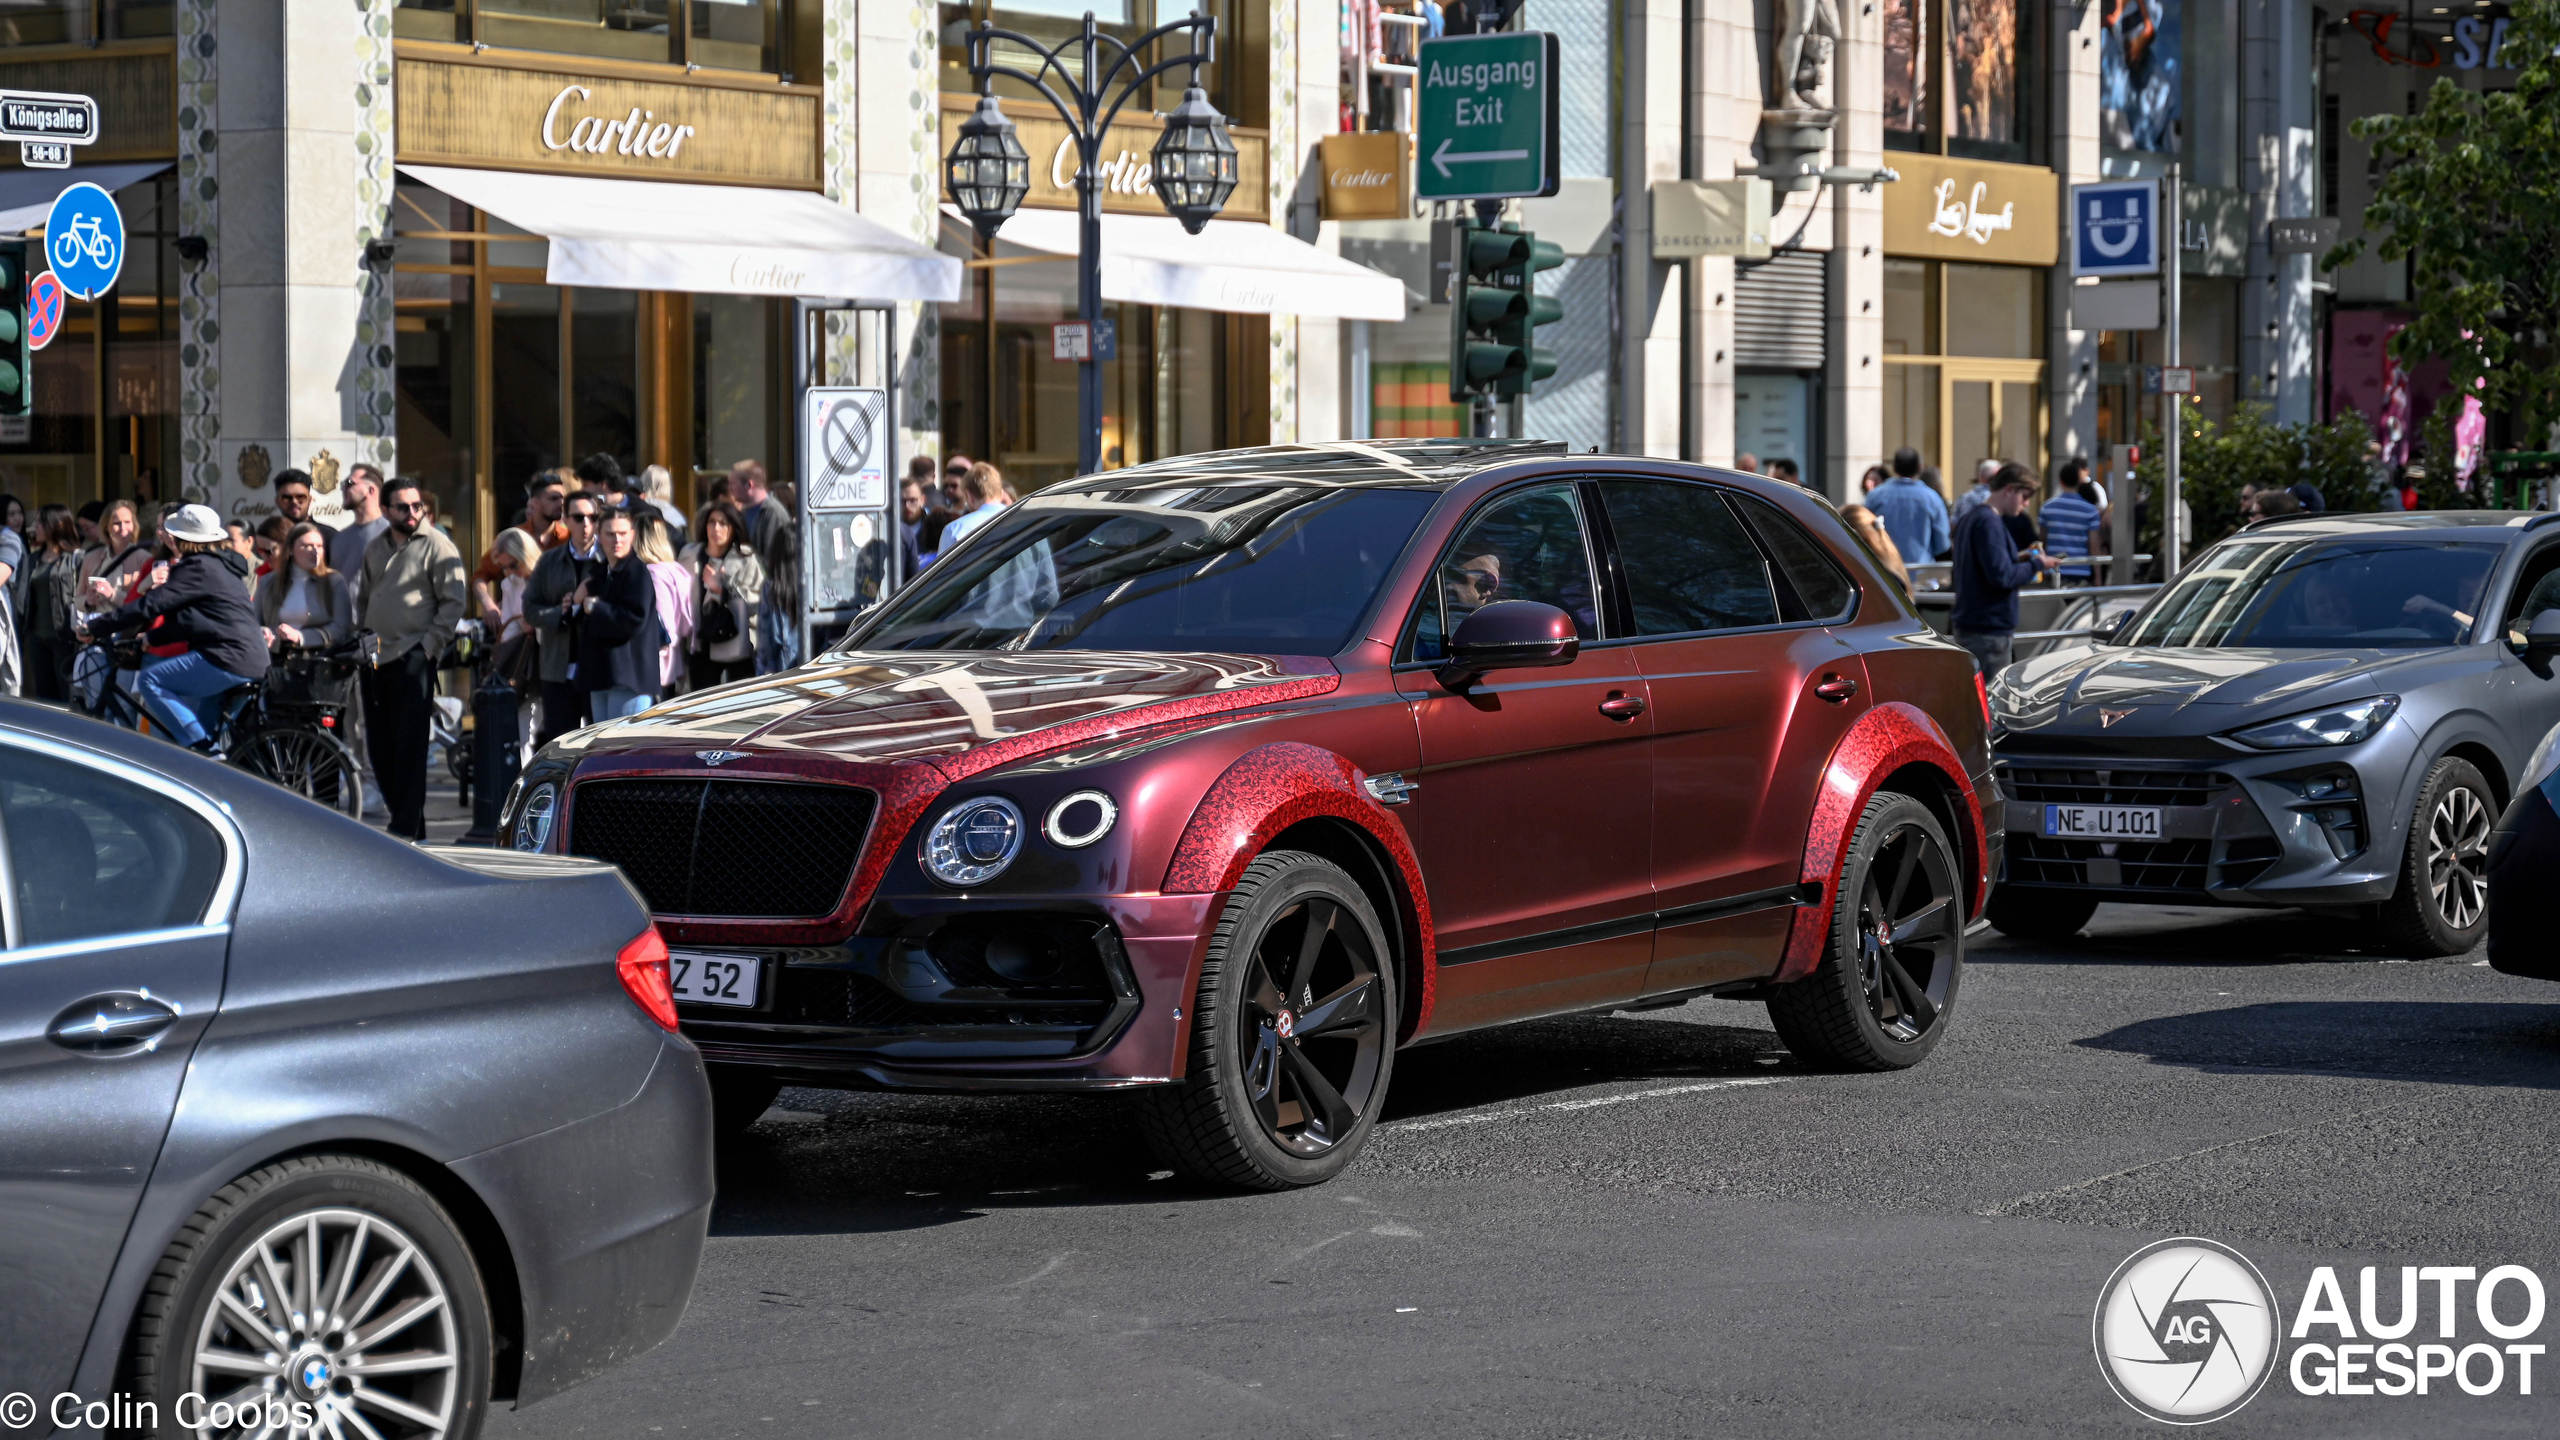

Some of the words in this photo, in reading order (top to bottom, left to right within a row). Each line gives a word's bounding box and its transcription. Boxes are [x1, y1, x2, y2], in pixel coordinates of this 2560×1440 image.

[1426, 60, 1536, 91] Ausgang
[8, 104, 84, 131] Königsallee
[543, 85, 694, 158] Cartier
[1456, 96, 1503, 126] Exit
[1330, 167, 1394, 188] Cartier
[730, 253, 805, 289] Cartier
[829, 481, 867, 500] ZONE
[2058, 809, 2085, 832] NE
[2099, 810, 2113, 833] U
[2117, 811, 2157, 834] 101
[672, 958, 691, 994] Z
[702, 961, 740, 999] 52
